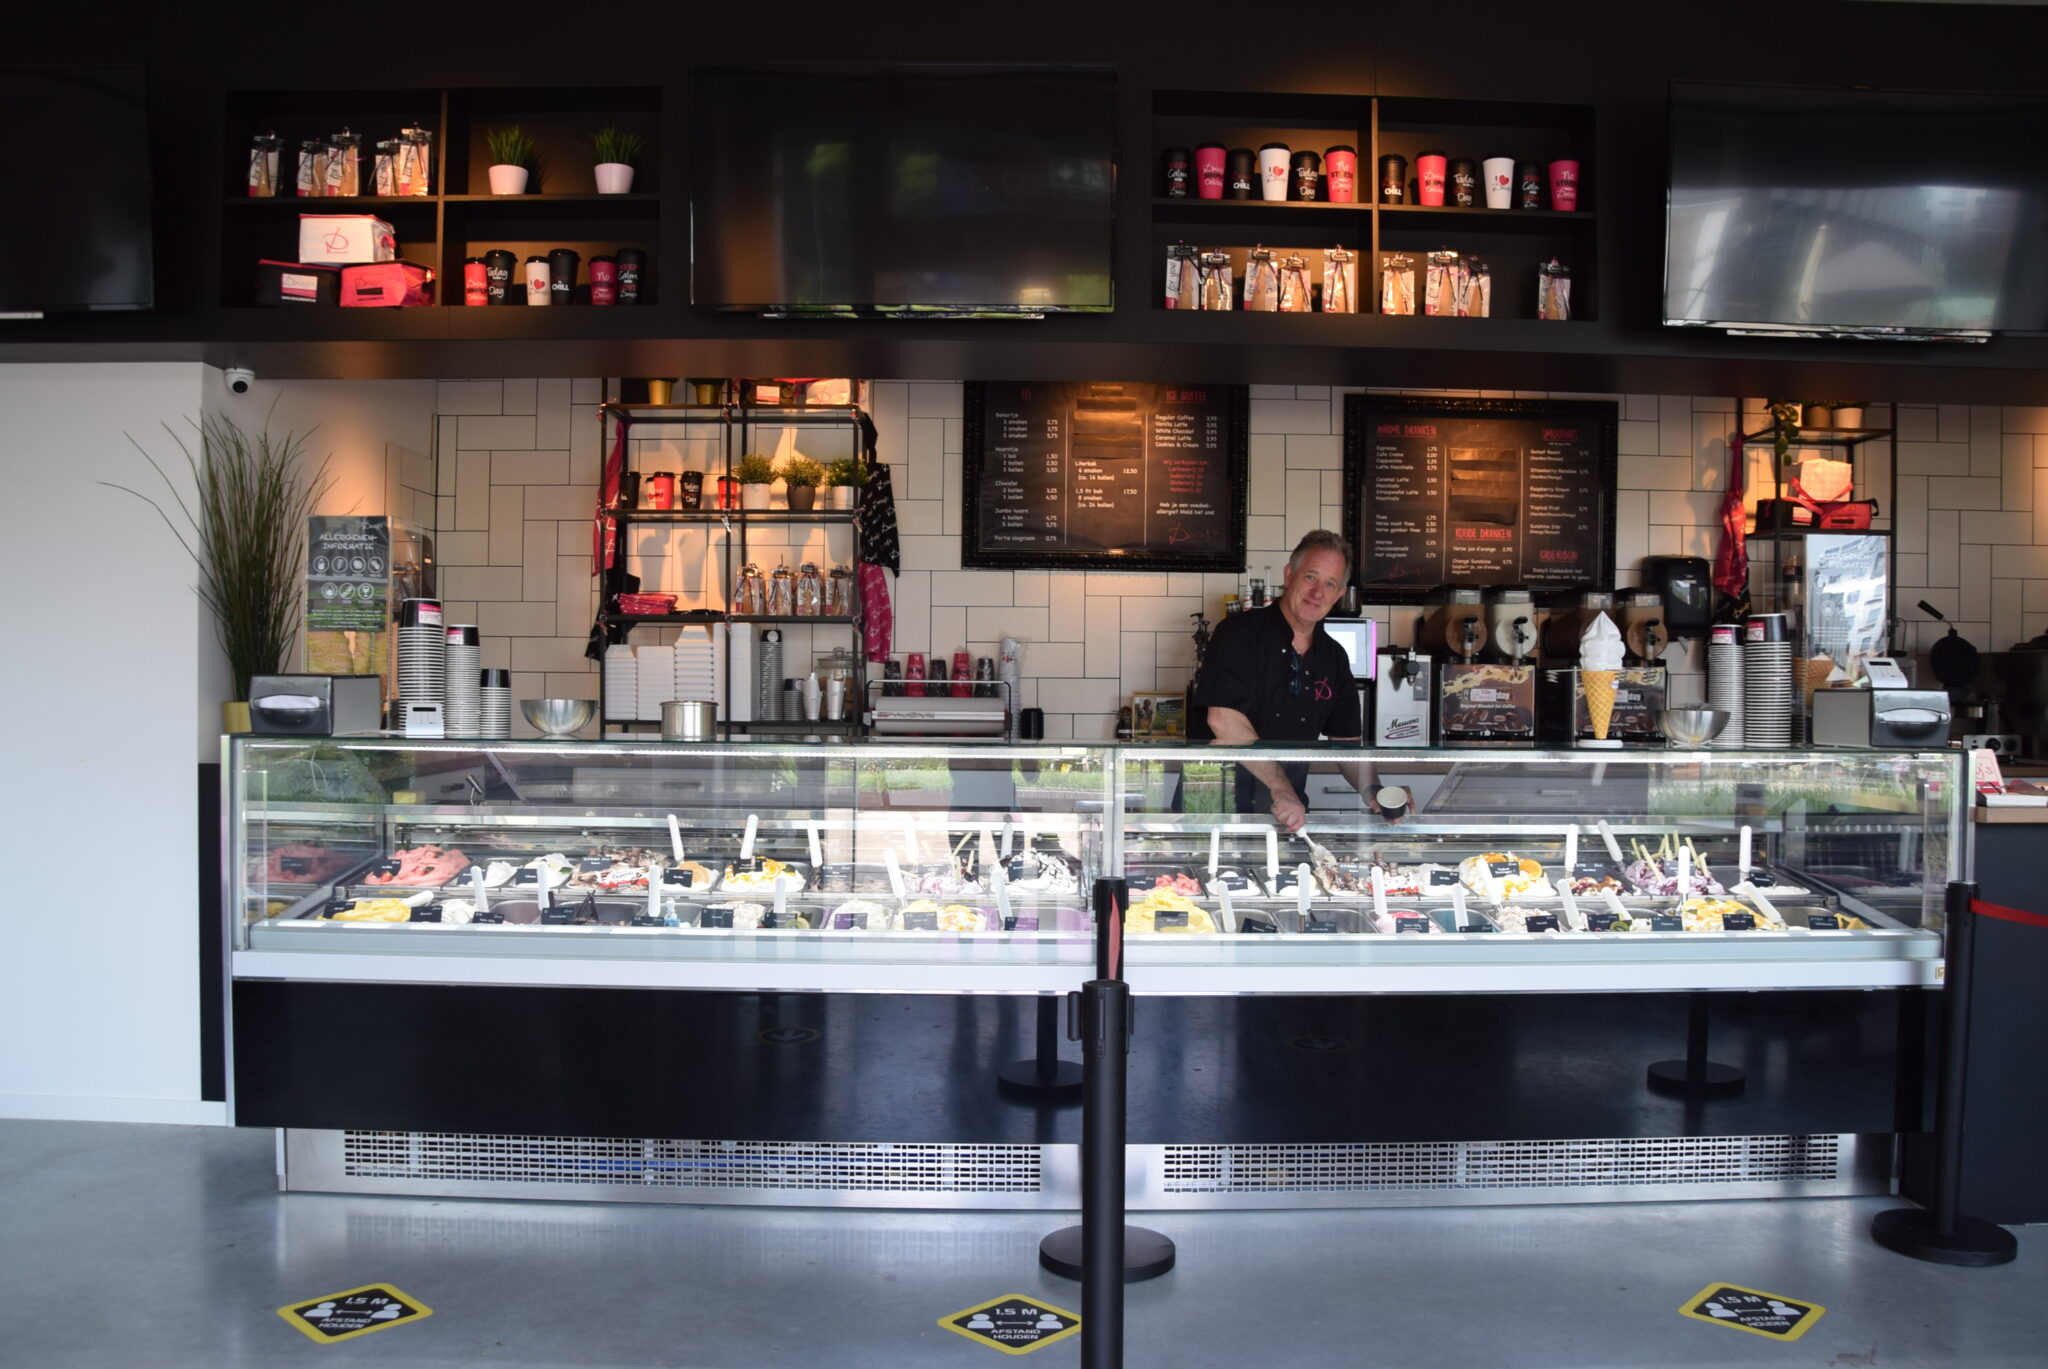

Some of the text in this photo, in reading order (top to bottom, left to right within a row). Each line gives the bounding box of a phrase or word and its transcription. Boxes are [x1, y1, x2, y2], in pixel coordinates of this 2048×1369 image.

[1300, 186, 1315, 199] Day
[1457, 192, 1472, 205] Day
[488, 286, 504, 299] Day
[1404, 425, 1437, 436] DRANKEN
[319, 533, 378, 541] ALLERGENEN-
[1455, 527, 1512, 538] KOUDE DRANKEN
[322, 542, 374, 550] INFORMATIE
[1743, 1295, 1762, 1303] M
[1021, 1308, 1038, 1316] M
